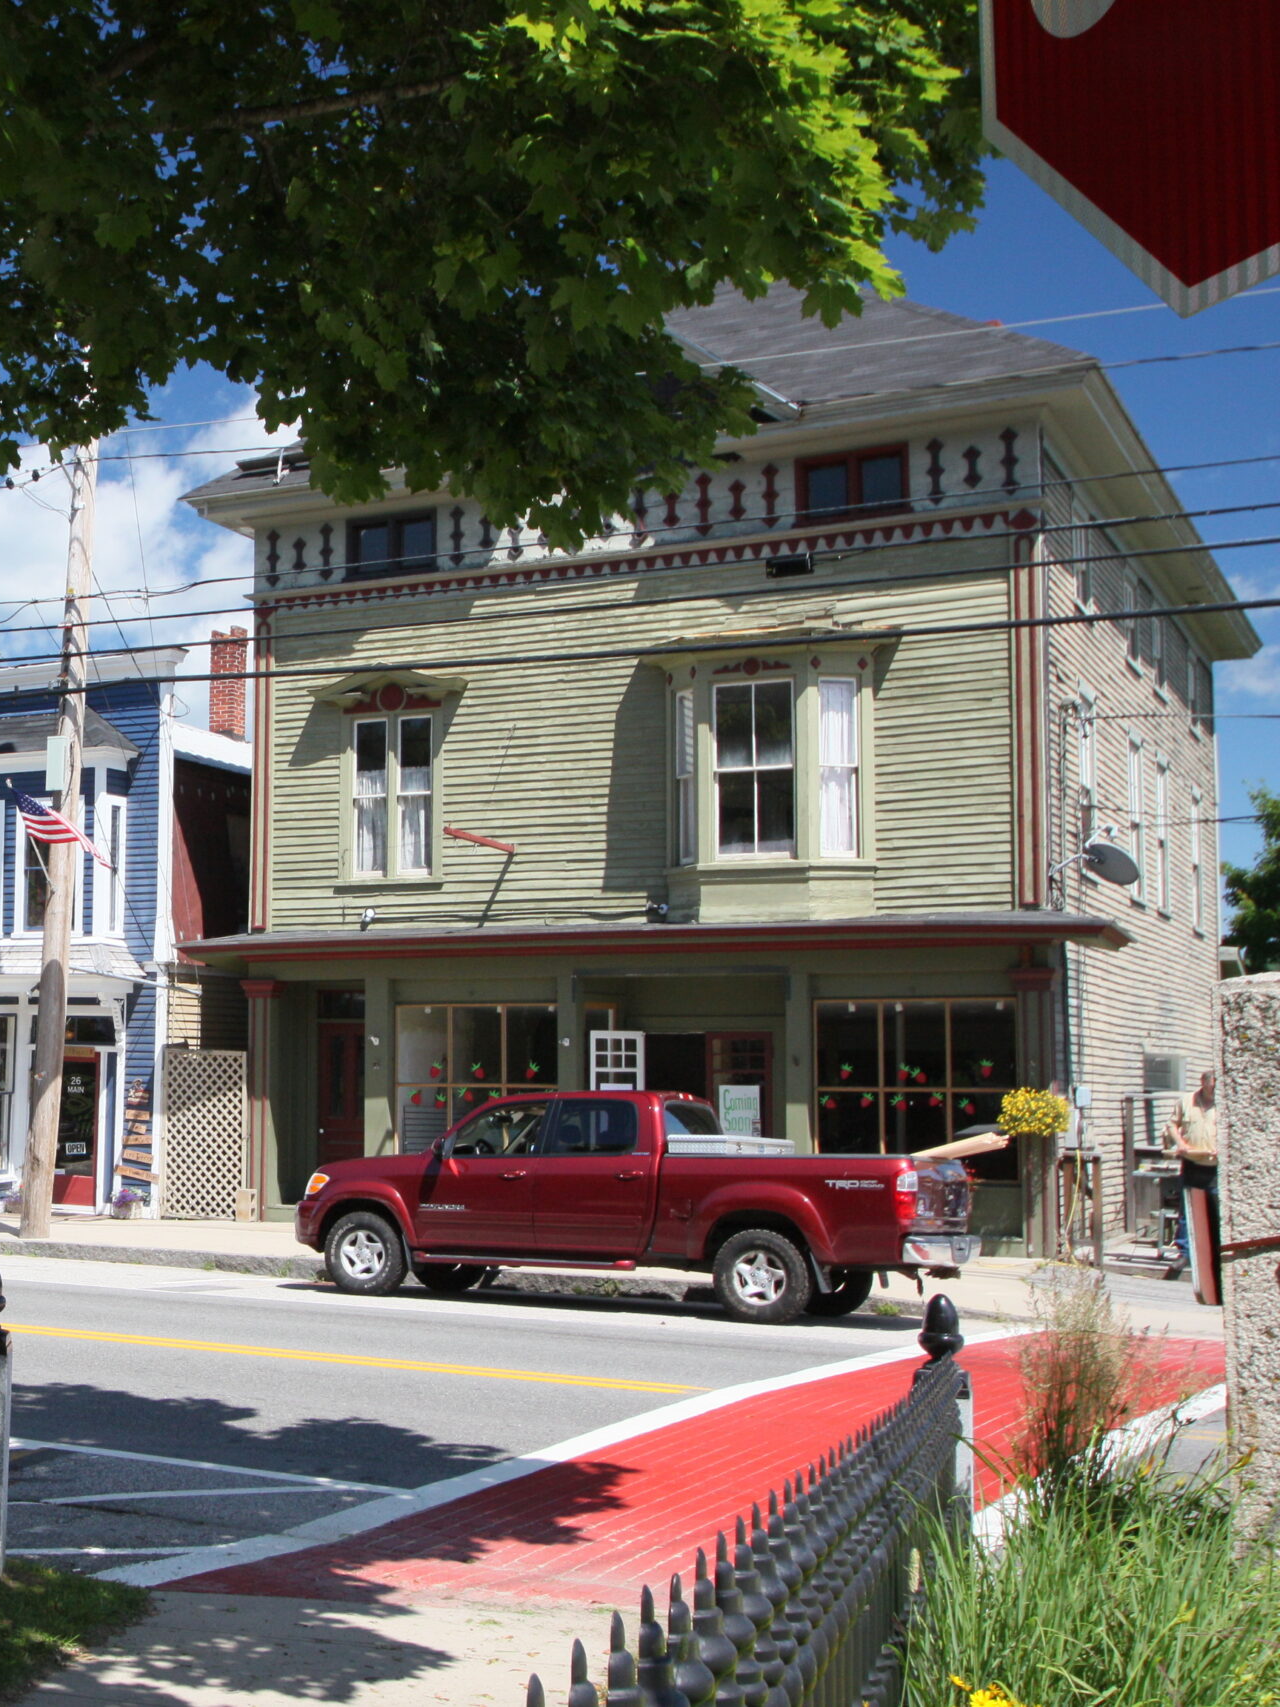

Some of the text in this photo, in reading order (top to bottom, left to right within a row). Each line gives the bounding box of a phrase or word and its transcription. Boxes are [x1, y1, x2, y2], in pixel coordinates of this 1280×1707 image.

[70, 1076, 81, 1085] 26
[67, 1086, 85, 1094] MAIN
[723, 1089, 758, 1118] Coming
[724, 1111, 751, 1132] Soon
[67, 1144, 85, 1153] OPEN
[824, 1179, 859, 1190] TRD
